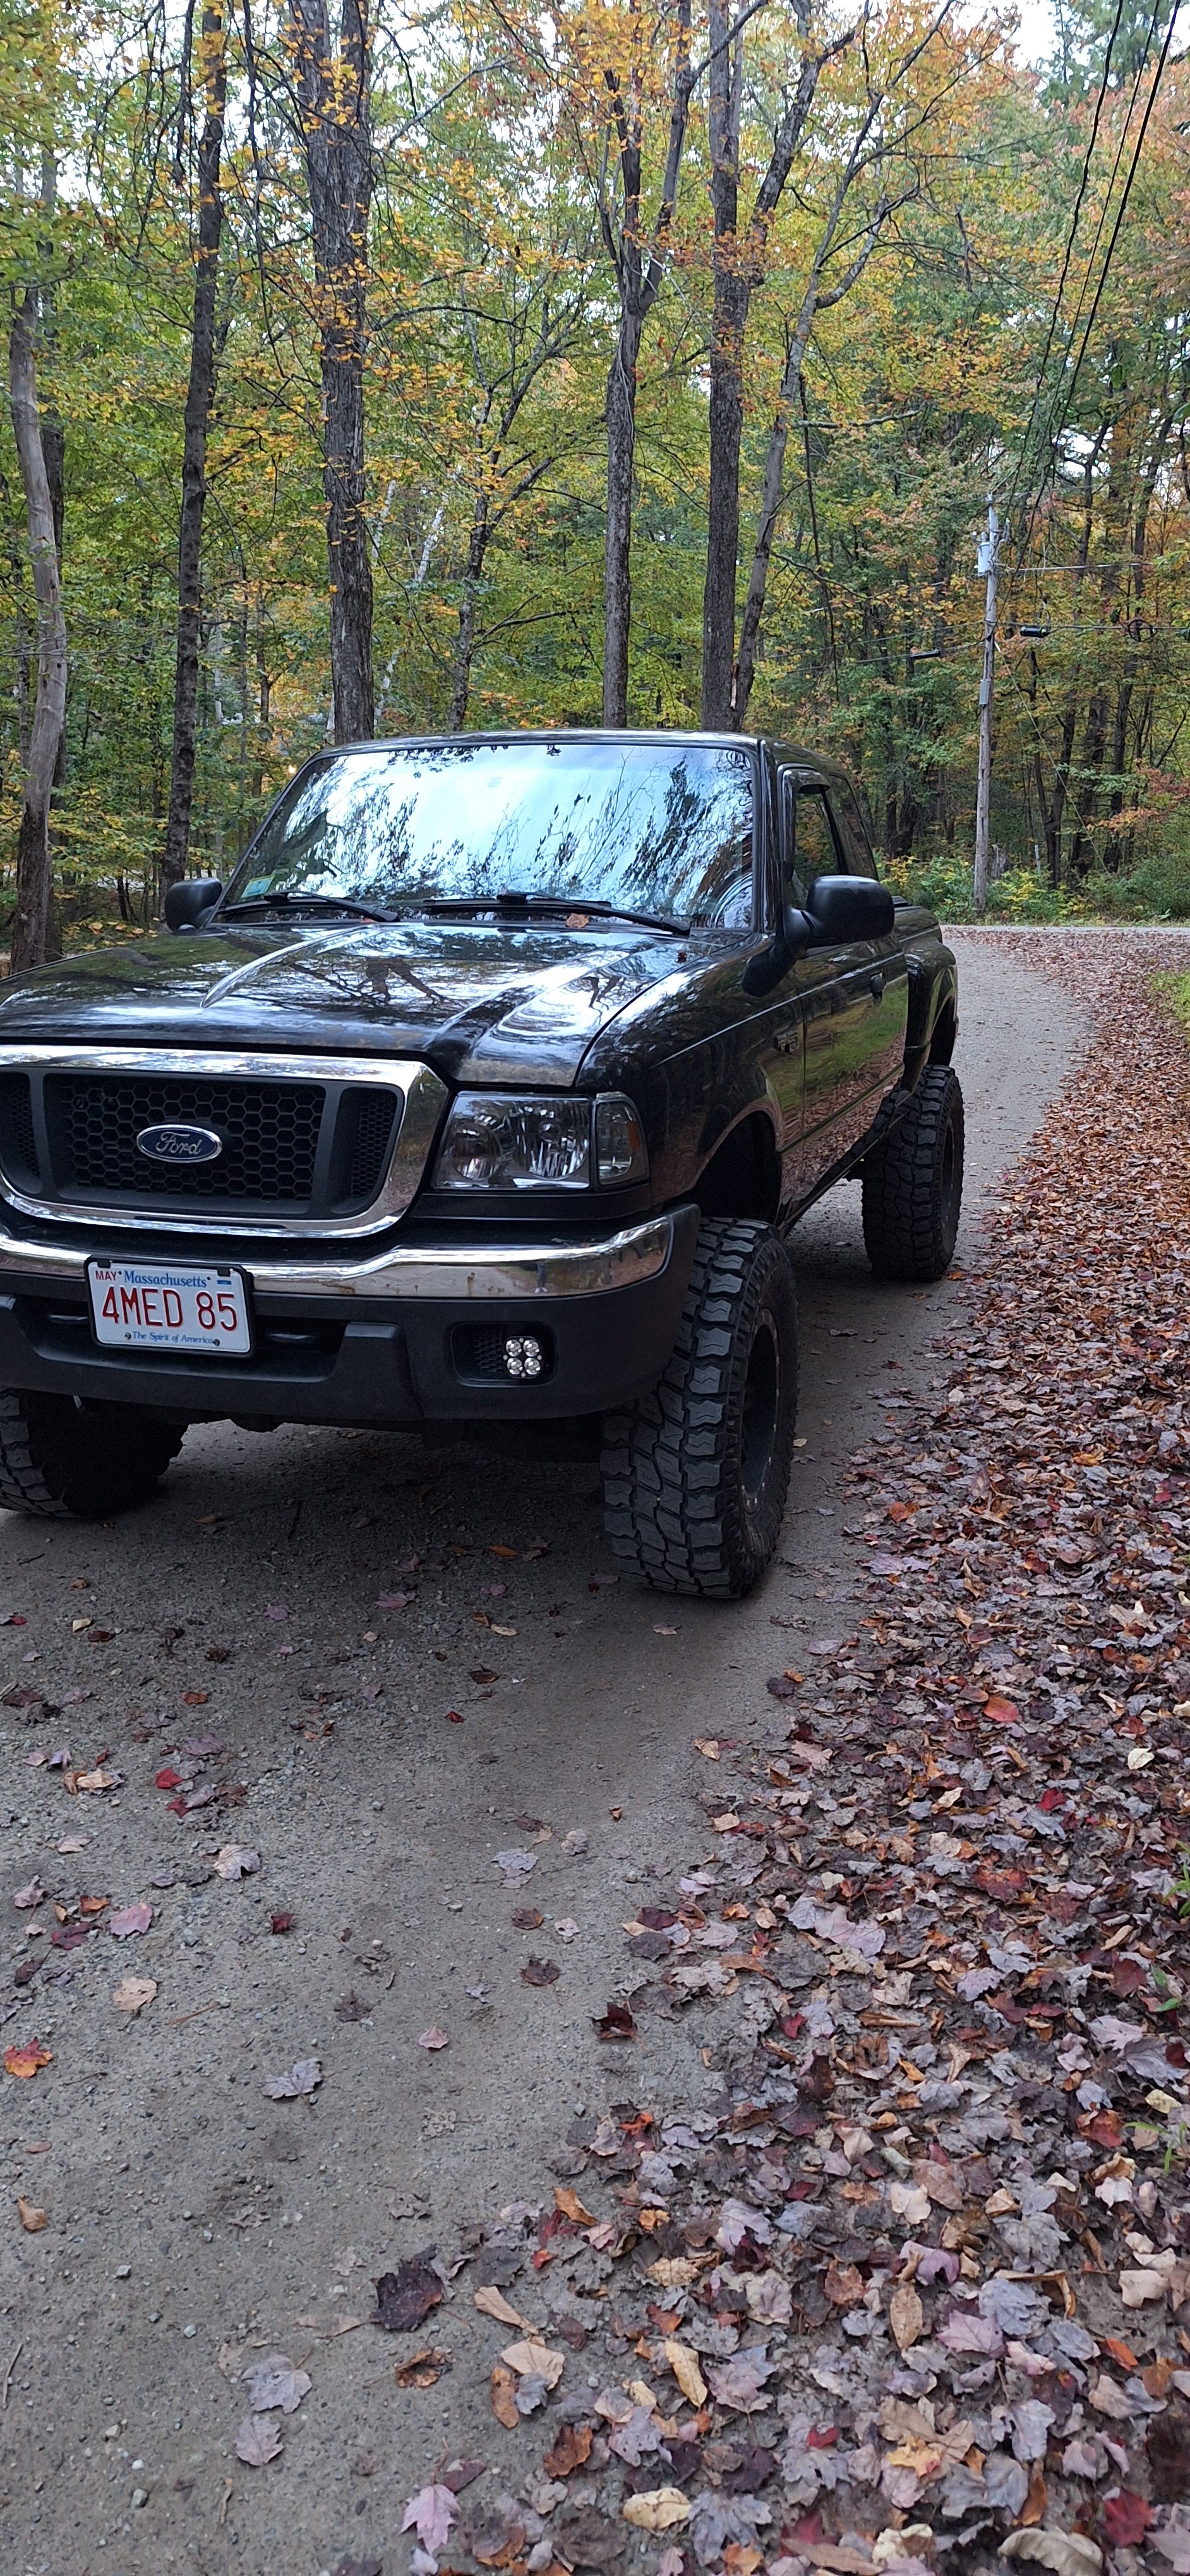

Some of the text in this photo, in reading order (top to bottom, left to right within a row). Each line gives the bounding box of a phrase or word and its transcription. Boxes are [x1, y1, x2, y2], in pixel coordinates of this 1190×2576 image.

[156, 1131, 202, 1155] Ford
[95, 1270, 117, 1281] MAY
[124, 1270, 207, 1287] Massachusetts
[102, 1286, 237, 1331] 4MED 85
[149, 1332, 169, 1342] Spirit
[171, 1334, 180, 1343] of
[181, 1334, 213, 1344] America
